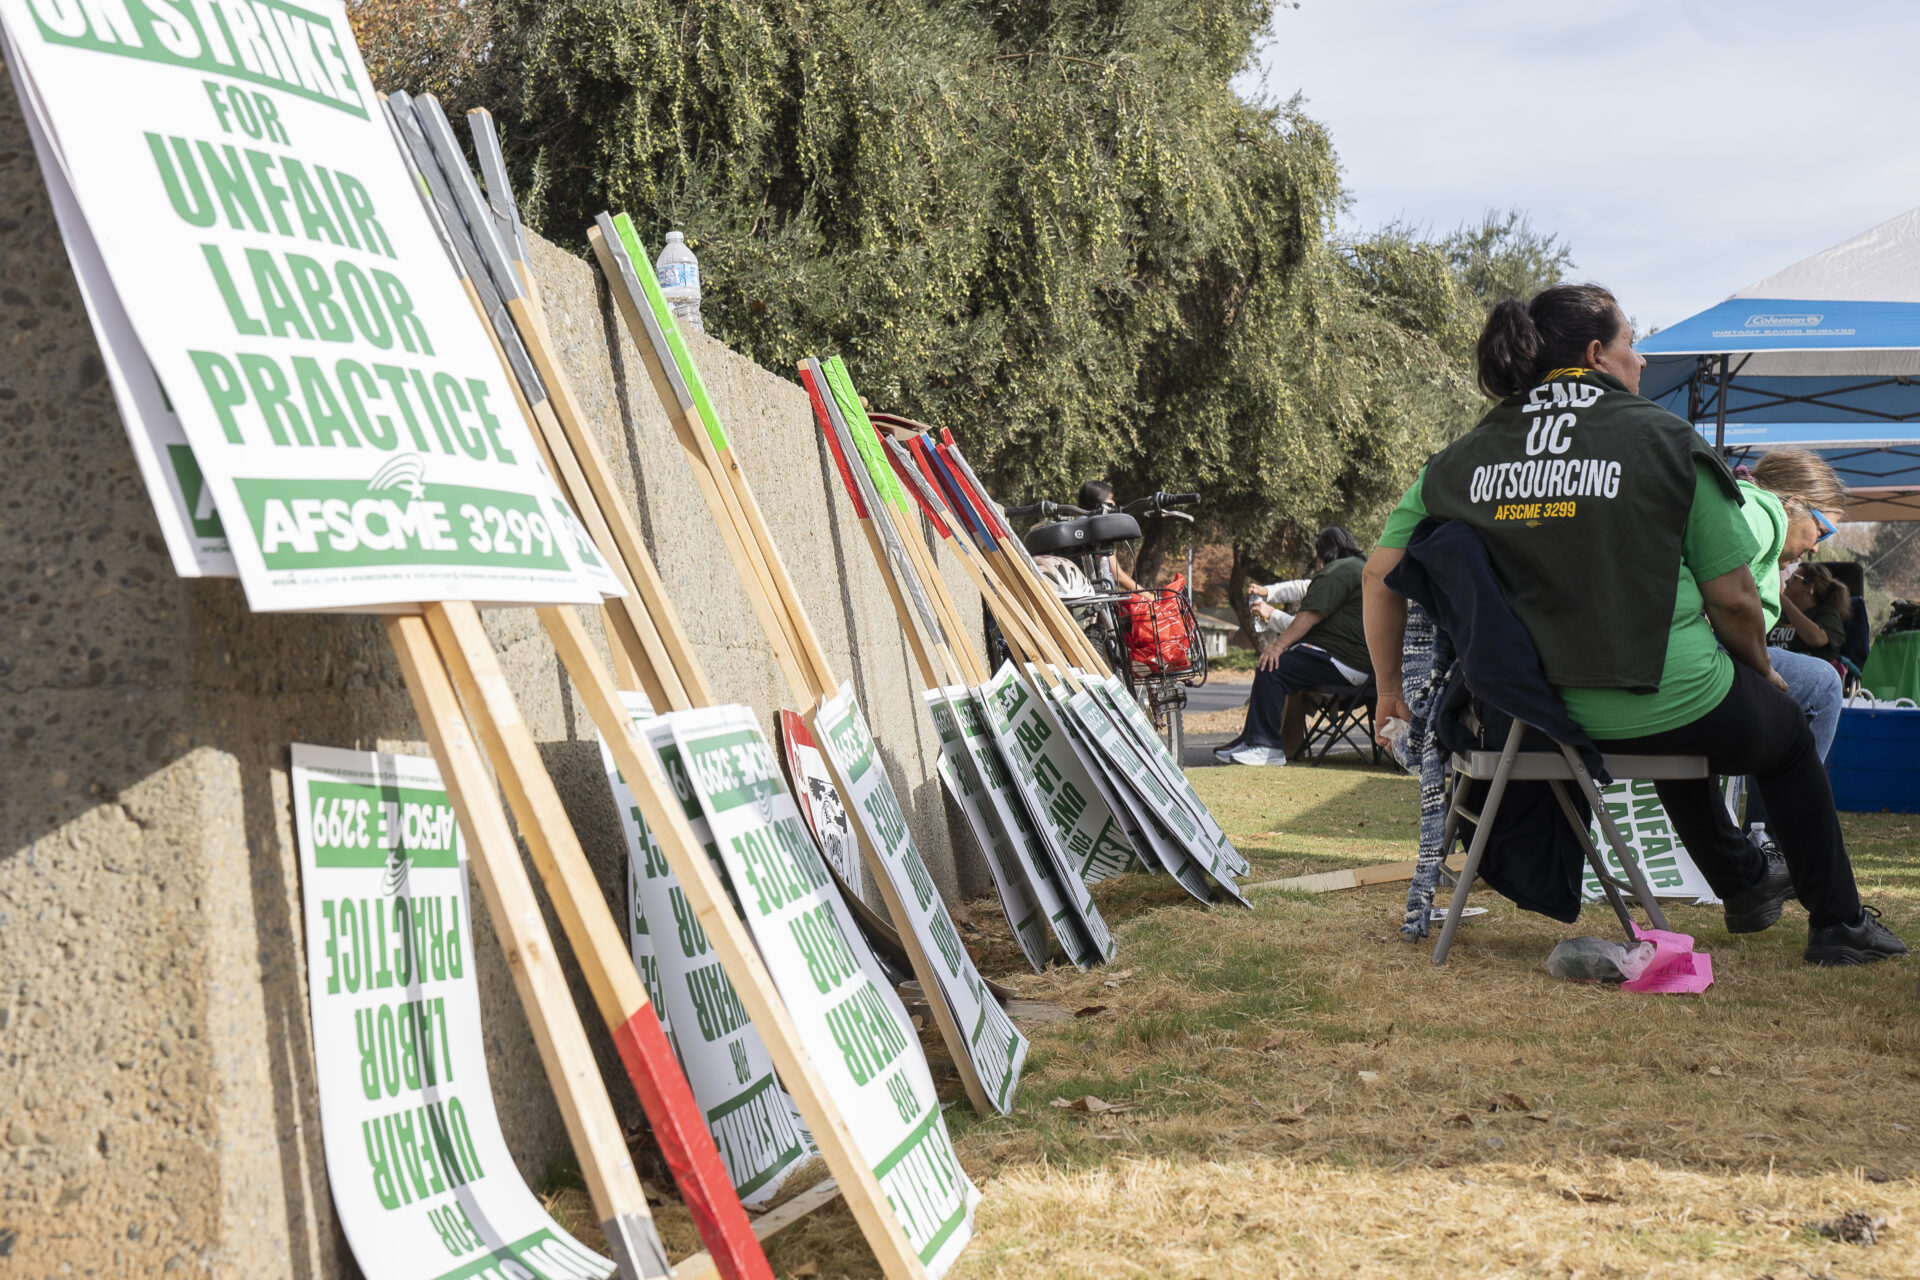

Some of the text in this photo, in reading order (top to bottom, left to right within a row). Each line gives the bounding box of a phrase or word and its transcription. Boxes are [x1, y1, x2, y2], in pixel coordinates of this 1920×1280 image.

[142, 0, 363, 110] STRIKE
[202, 80, 291, 147] FOR
[143, 131, 398, 260] UNFAIR
[200, 243, 436, 356] LABOR
[186, 350, 518, 466] PRACTICE
[1522, 383, 1605, 413] END
[1526, 413, 1577, 456] UC
[1470, 459, 1621, 503] OUTSOURCING
[1494, 501, 1577, 521] AFSCME 3299
[263, 499, 459, 554] AFSCME
[459, 503, 554, 557] 3299
[1769, 627, 1796, 642] END
[696, 747, 740, 797] 3299
[835, 727, 864, 771] 3299
[313, 797, 455, 850] AFSCME 3299
[1068, 829, 1093, 857] FOR
[1631, 779, 1684, 888] UNFAIR
[731, 816, 829, 916] PRACTICE
[322, 896, 464, 994] PRACTICE
[788, 899, 861, 995] LABOR
[355, 997, 453, 1100] LABOR
[729, 1038, 752, 1086] FOR
[824, 980, 908, 1087] UNFAIR
[762, 1083, 796, 1156] ON
[886, 1068, 921, 1125] FOR
[362, 1096, 485, 1211] UNFAIR
[428, 1201, 485, 1257] FOR
